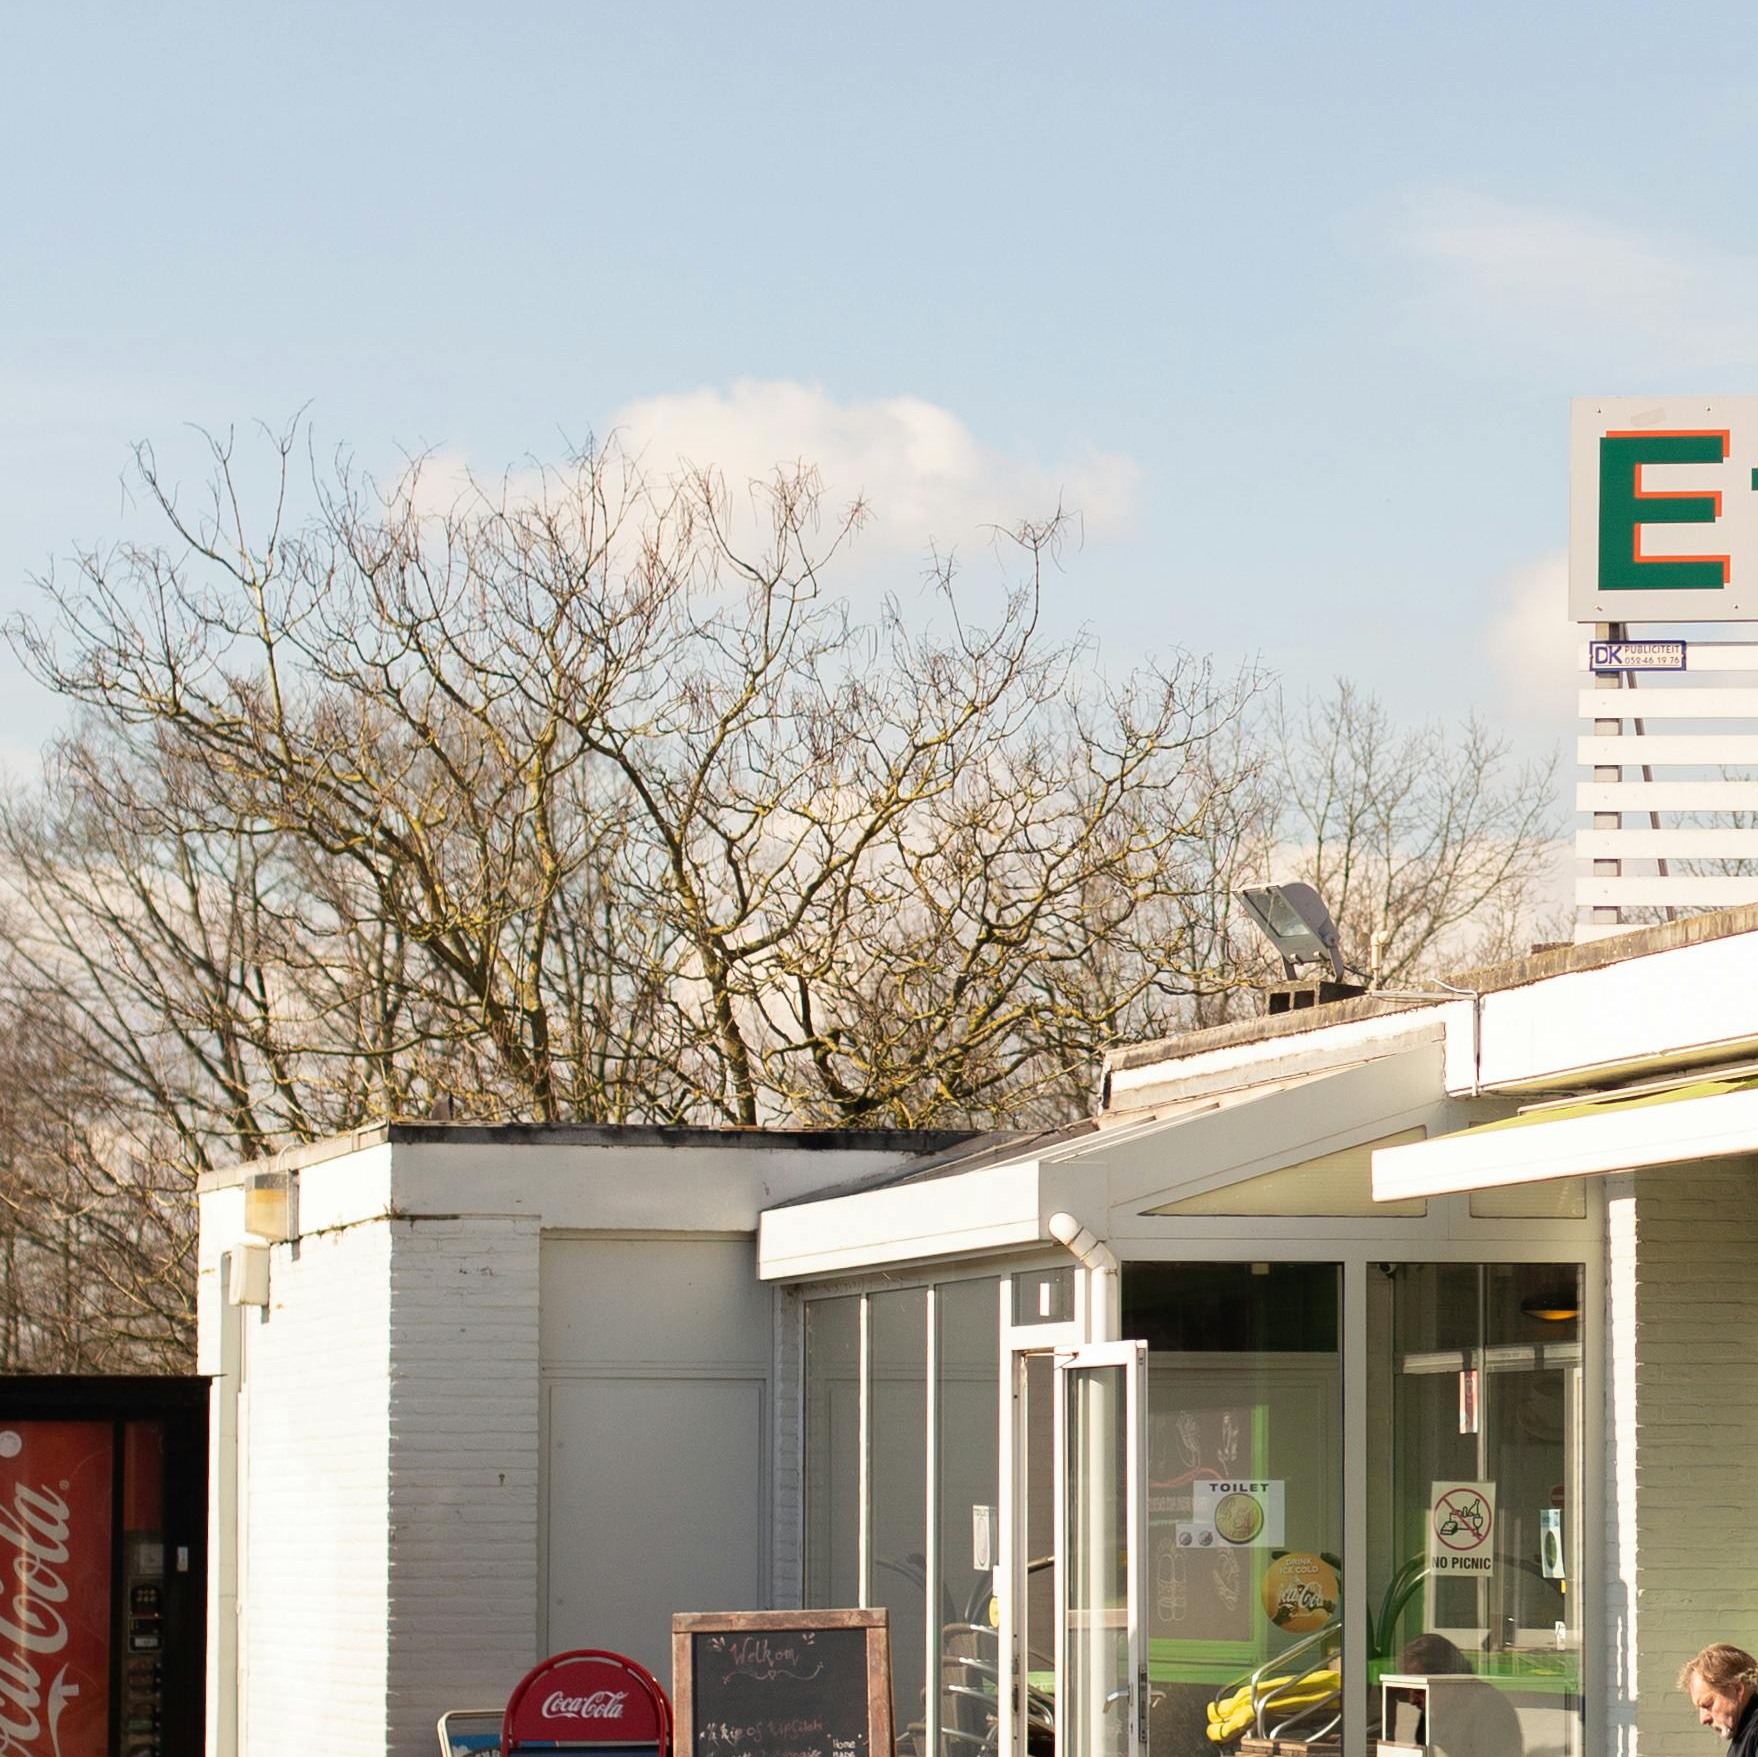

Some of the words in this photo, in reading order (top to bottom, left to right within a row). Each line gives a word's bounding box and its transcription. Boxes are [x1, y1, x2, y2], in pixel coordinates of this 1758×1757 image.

[1595, 645, 1622, 664] DK
[1625, 645, 1680, 654] PUBLICITEIT
[1209, 1483, 1270, 1492] TOILET
[1433, 1557, 1448, 1569] NO
[1452, 1557, 1491, 1569] PICNIC
[729, 1637, 799, 1667] Welkom
[541, 1691, 628, 1719] Coca-Cola
